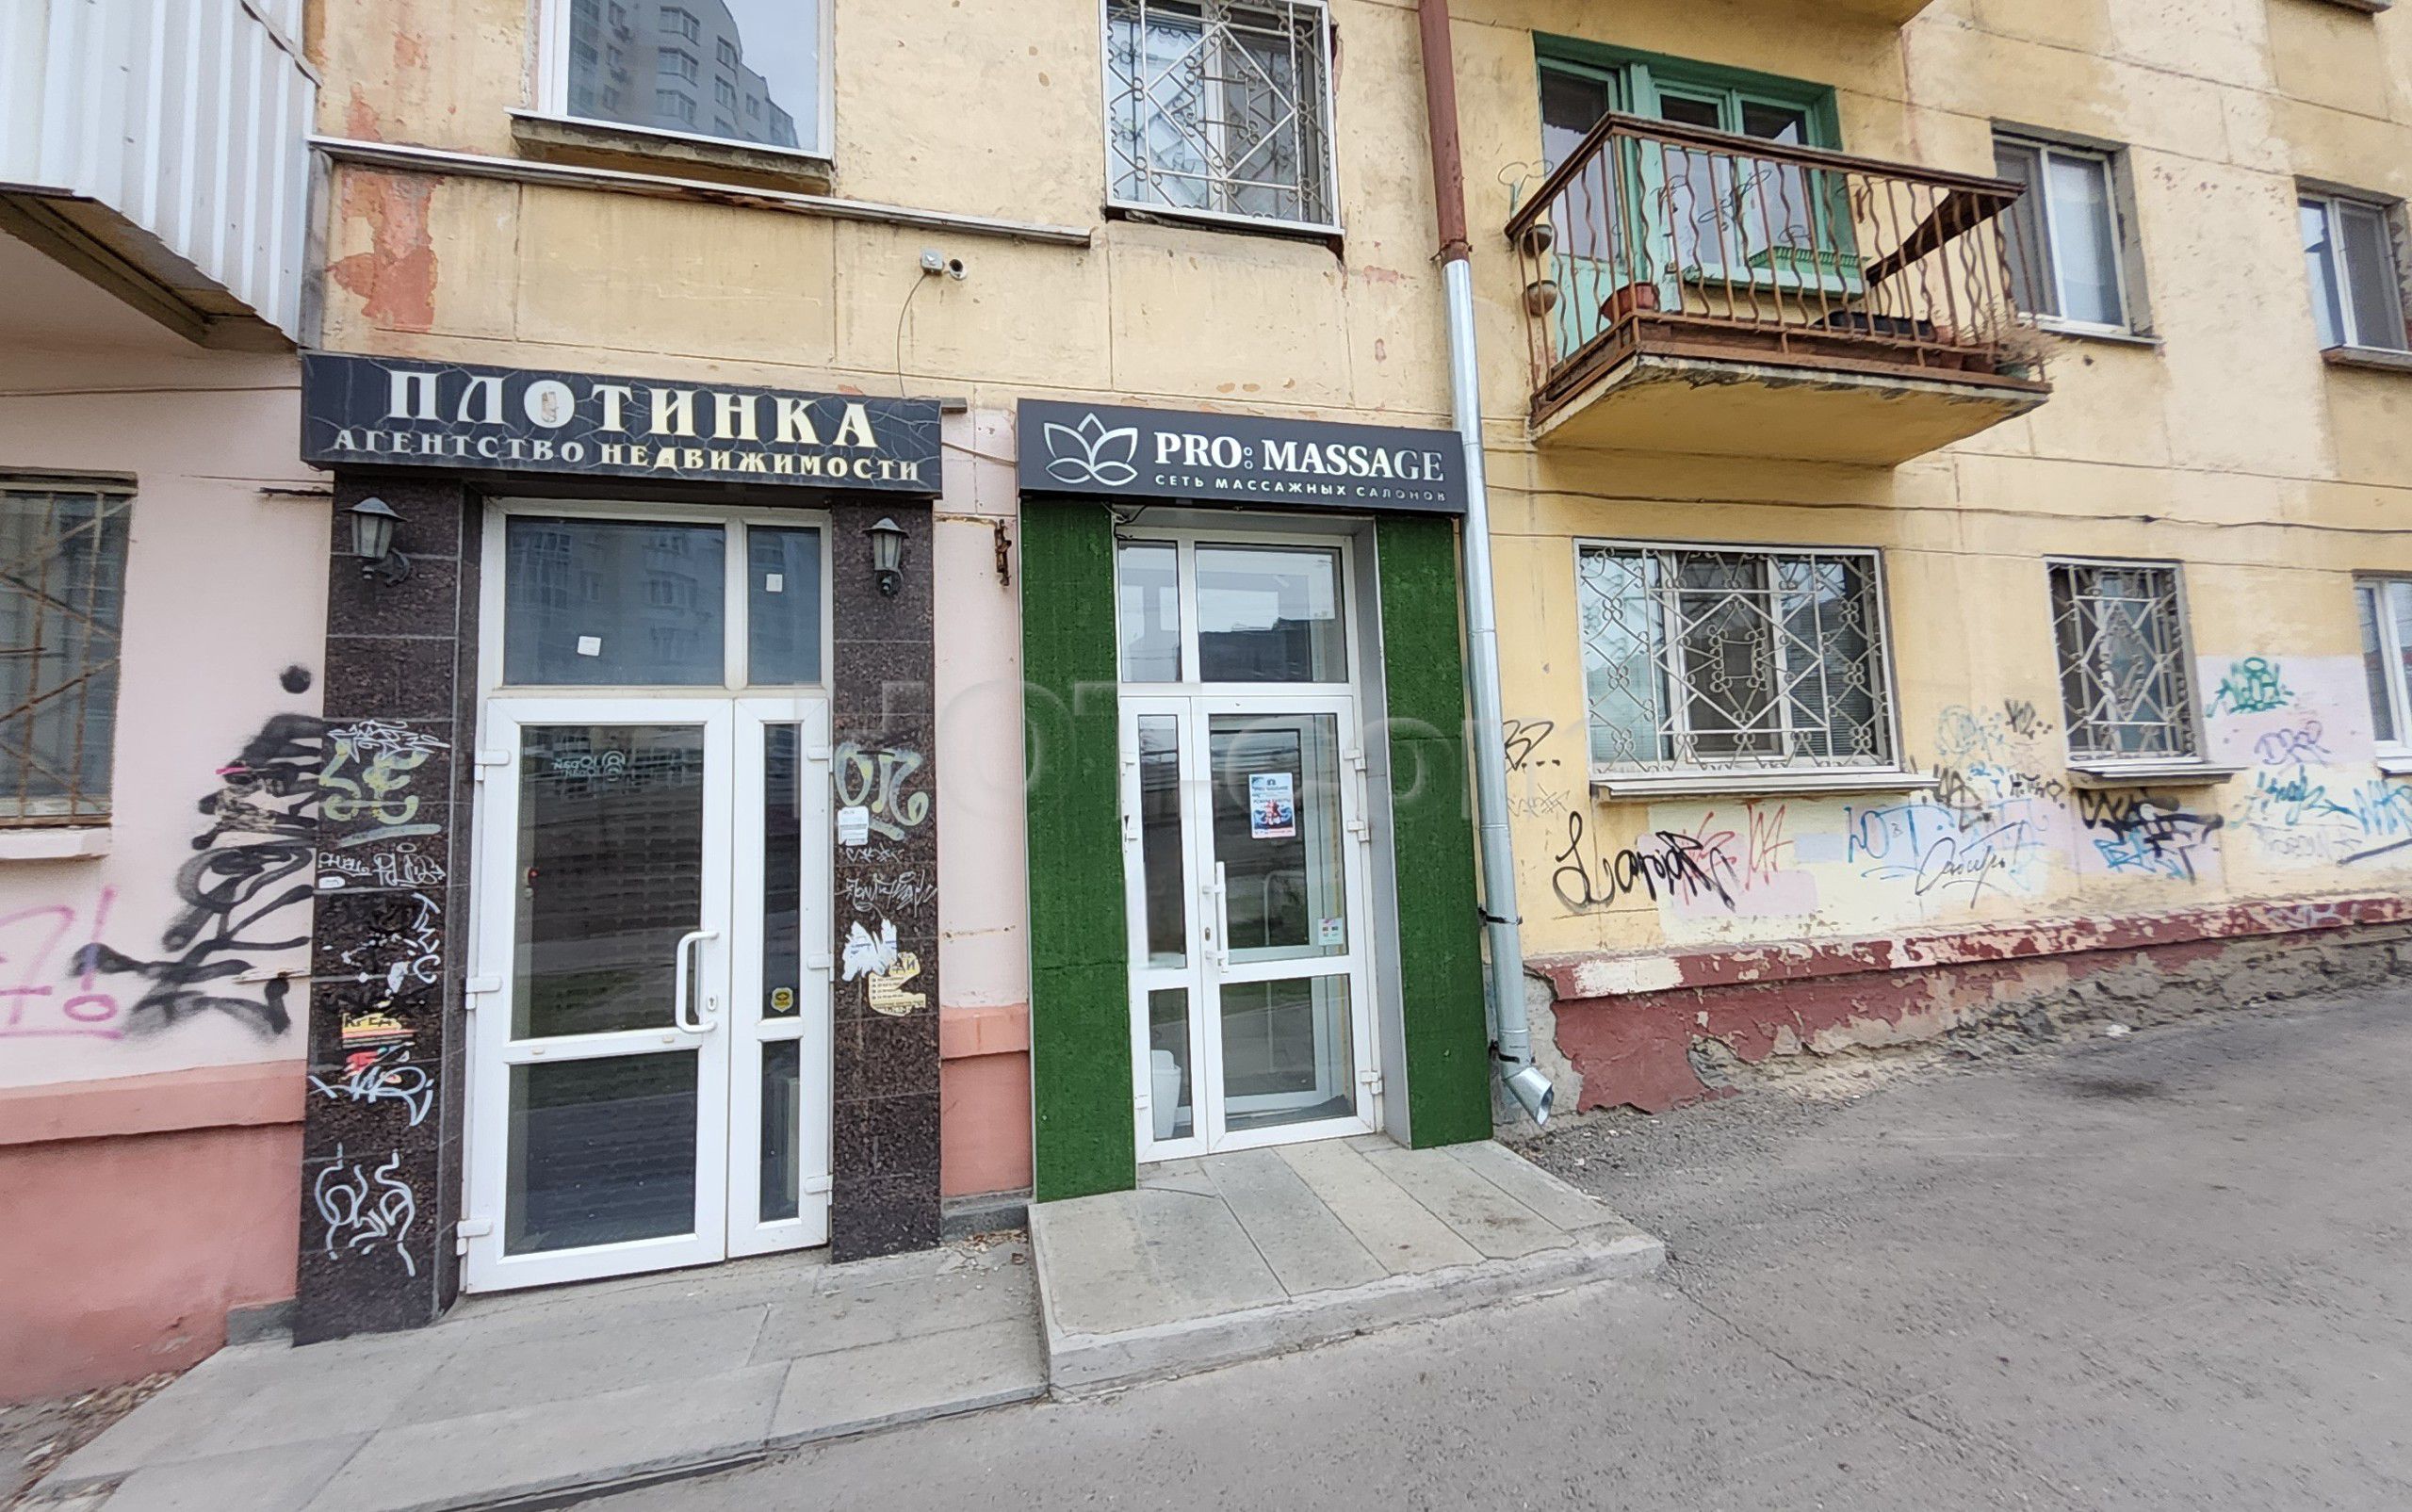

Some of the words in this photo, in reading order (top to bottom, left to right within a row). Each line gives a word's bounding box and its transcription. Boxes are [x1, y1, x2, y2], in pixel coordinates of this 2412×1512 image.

[385, 370, 878, 447] ПЛОТИНКА
[333, 430, 584, 463] АГЕНТСТВО
[601, 443, 919, 481] НЕДВИЖИМОСТИ
[1262, 439, 1443, 481] MASSAGE
[1155, 474, 1205, 488] СЕТЬ
[1215, 478, 1347, 496] МАССАЖНЫХ
